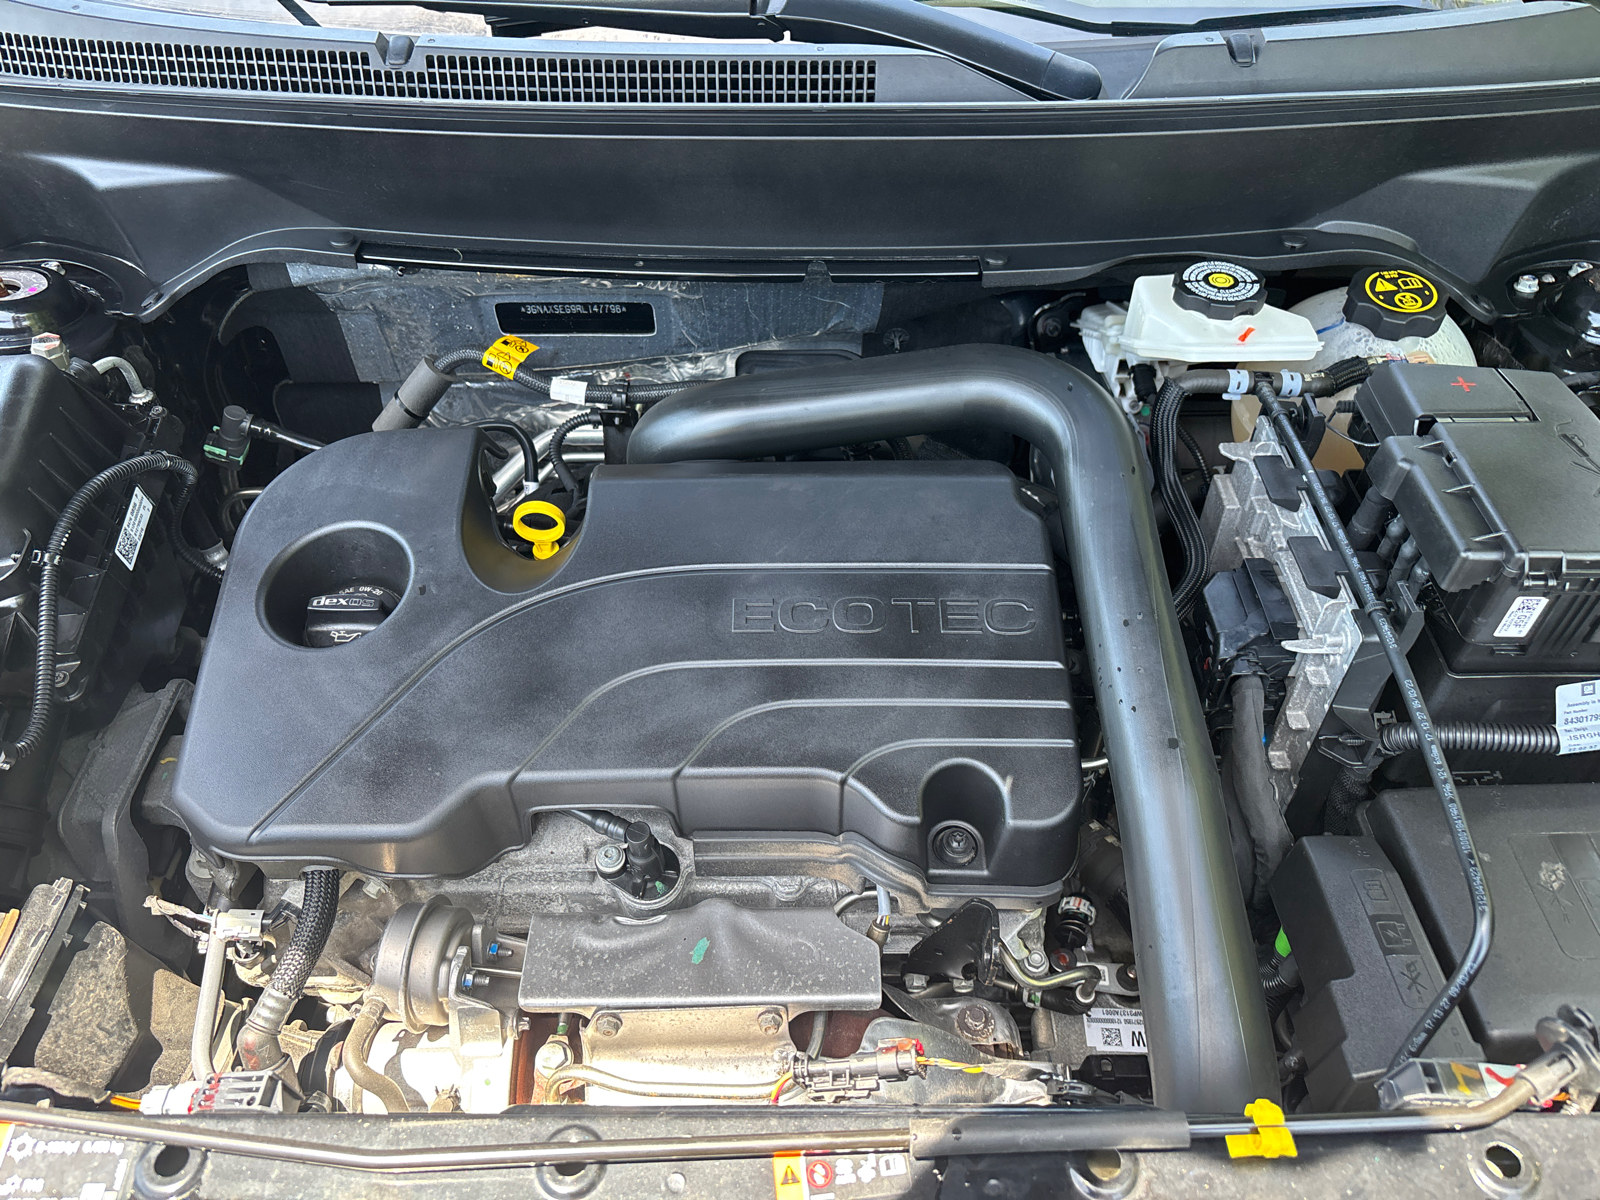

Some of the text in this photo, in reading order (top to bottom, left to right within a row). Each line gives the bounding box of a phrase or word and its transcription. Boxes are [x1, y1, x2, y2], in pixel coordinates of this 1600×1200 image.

[312, 596, 375, 607] dexos
[731, 596, 1037, 635] ECOTEC
[1424, 997, 1451, 1030] 17:13:27
